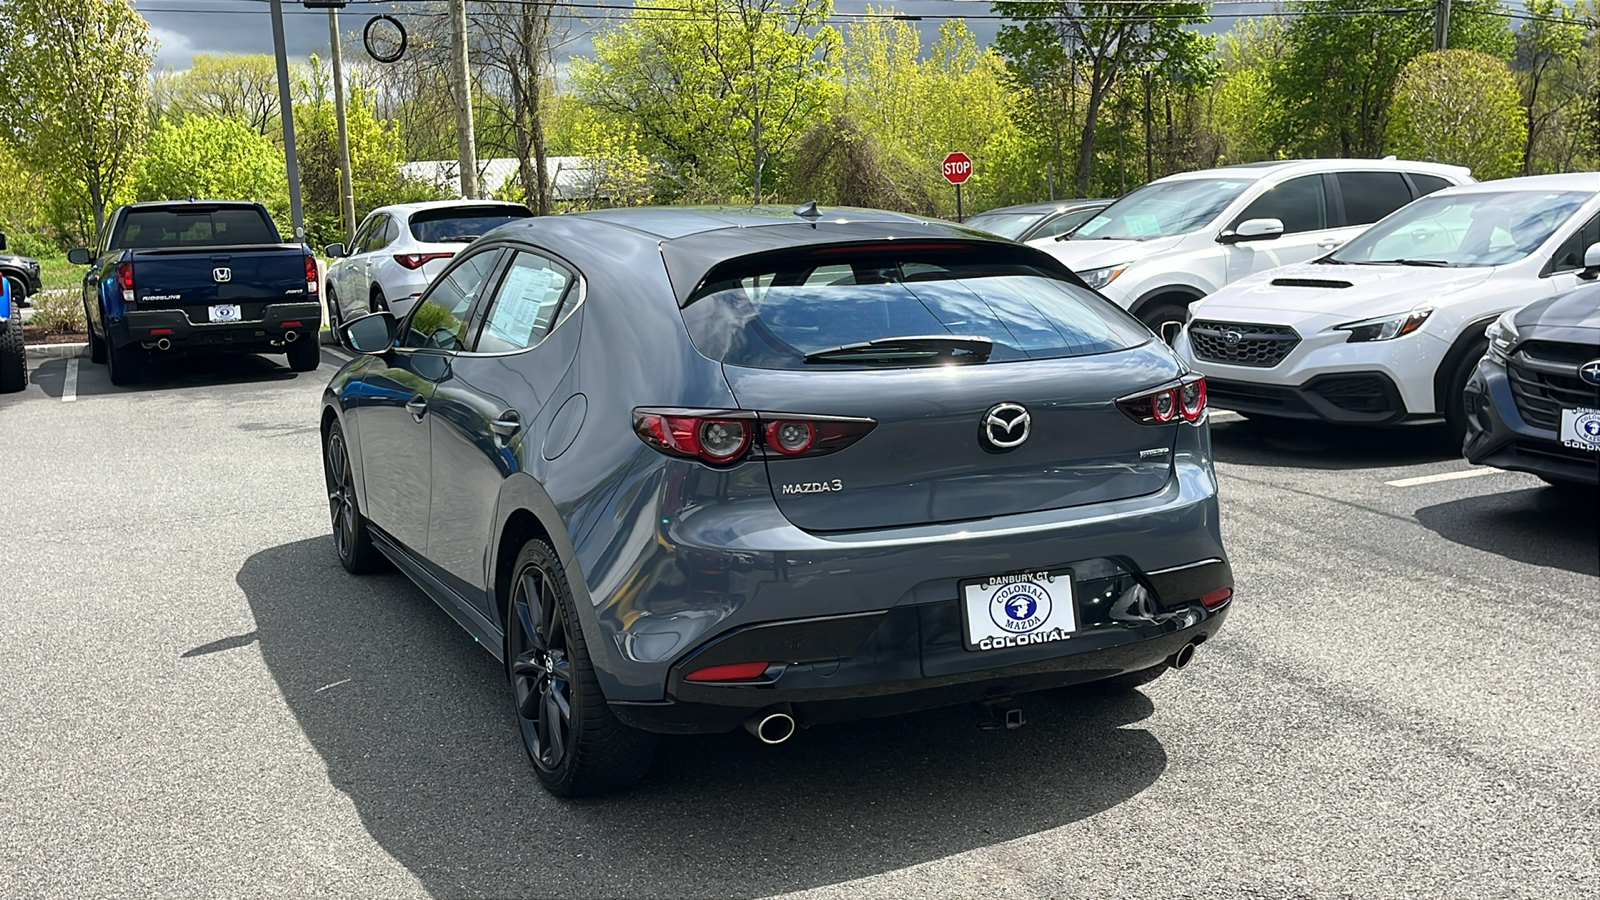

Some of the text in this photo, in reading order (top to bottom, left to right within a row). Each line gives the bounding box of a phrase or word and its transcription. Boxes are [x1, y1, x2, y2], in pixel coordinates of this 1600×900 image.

[944, 161, 970, 175] STOP
[1037, 571, 1049, 581] CT
[996, 584, 1043, 604] COLONIAL
[1005, 616, 1041, 630] MAZDA
[980, 630, 1071, 651] COLONIAL
